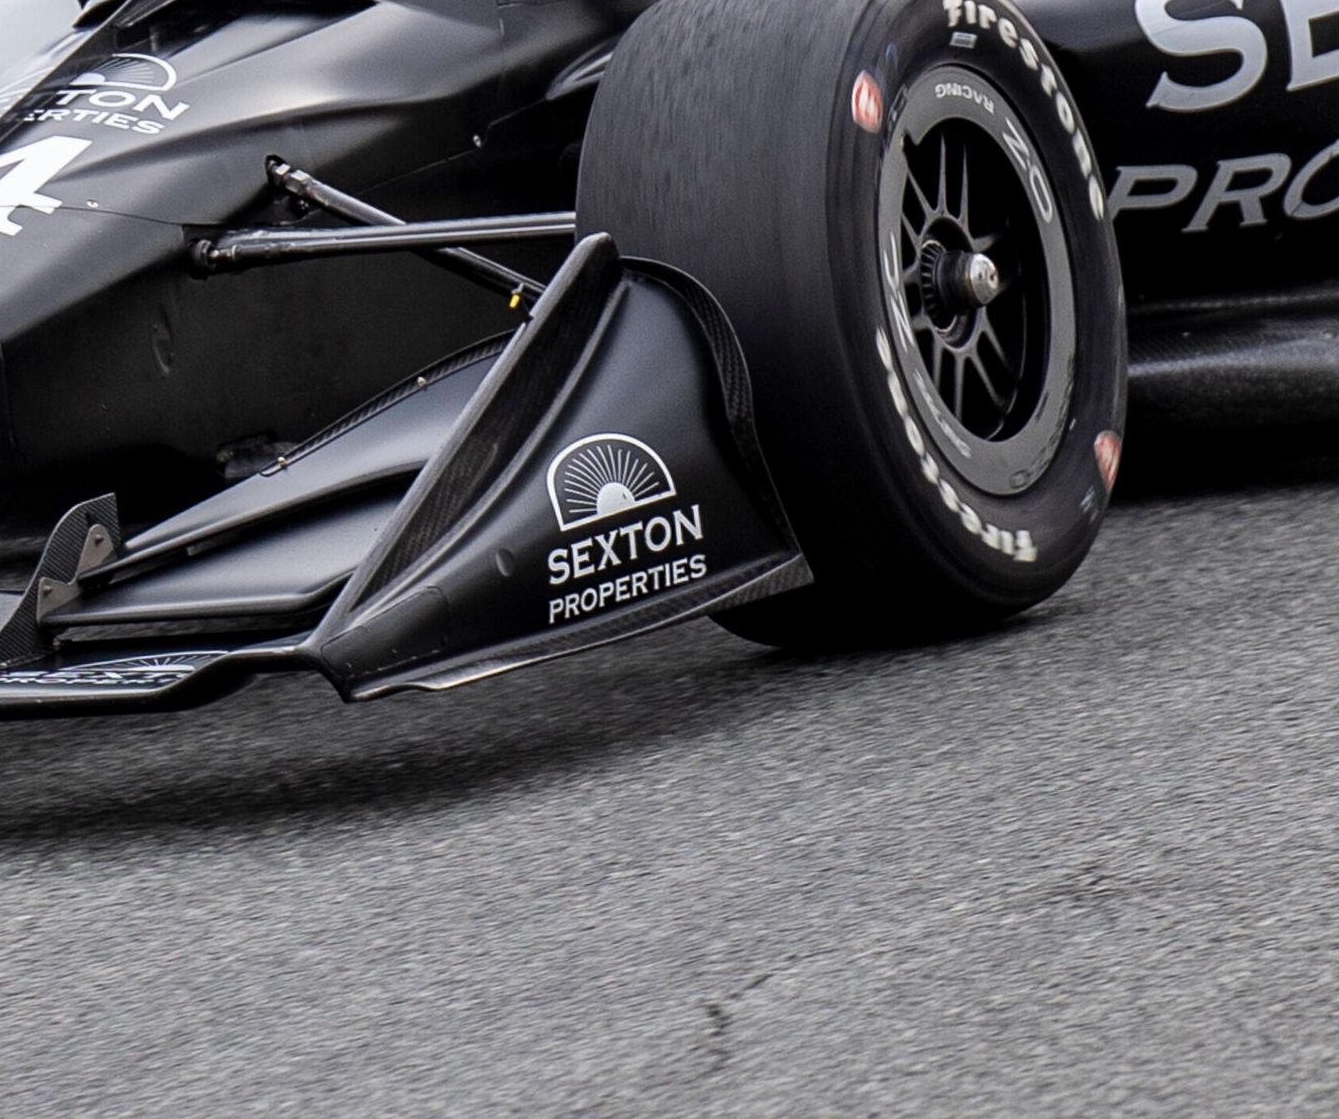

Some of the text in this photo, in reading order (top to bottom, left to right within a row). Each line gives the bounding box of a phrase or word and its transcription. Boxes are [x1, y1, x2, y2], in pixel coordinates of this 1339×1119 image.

[934, 82, 996, 116] RACING
[547, 503, 704, 585] SEXTON
[548, 553, 708, 625] PROPERTIES
